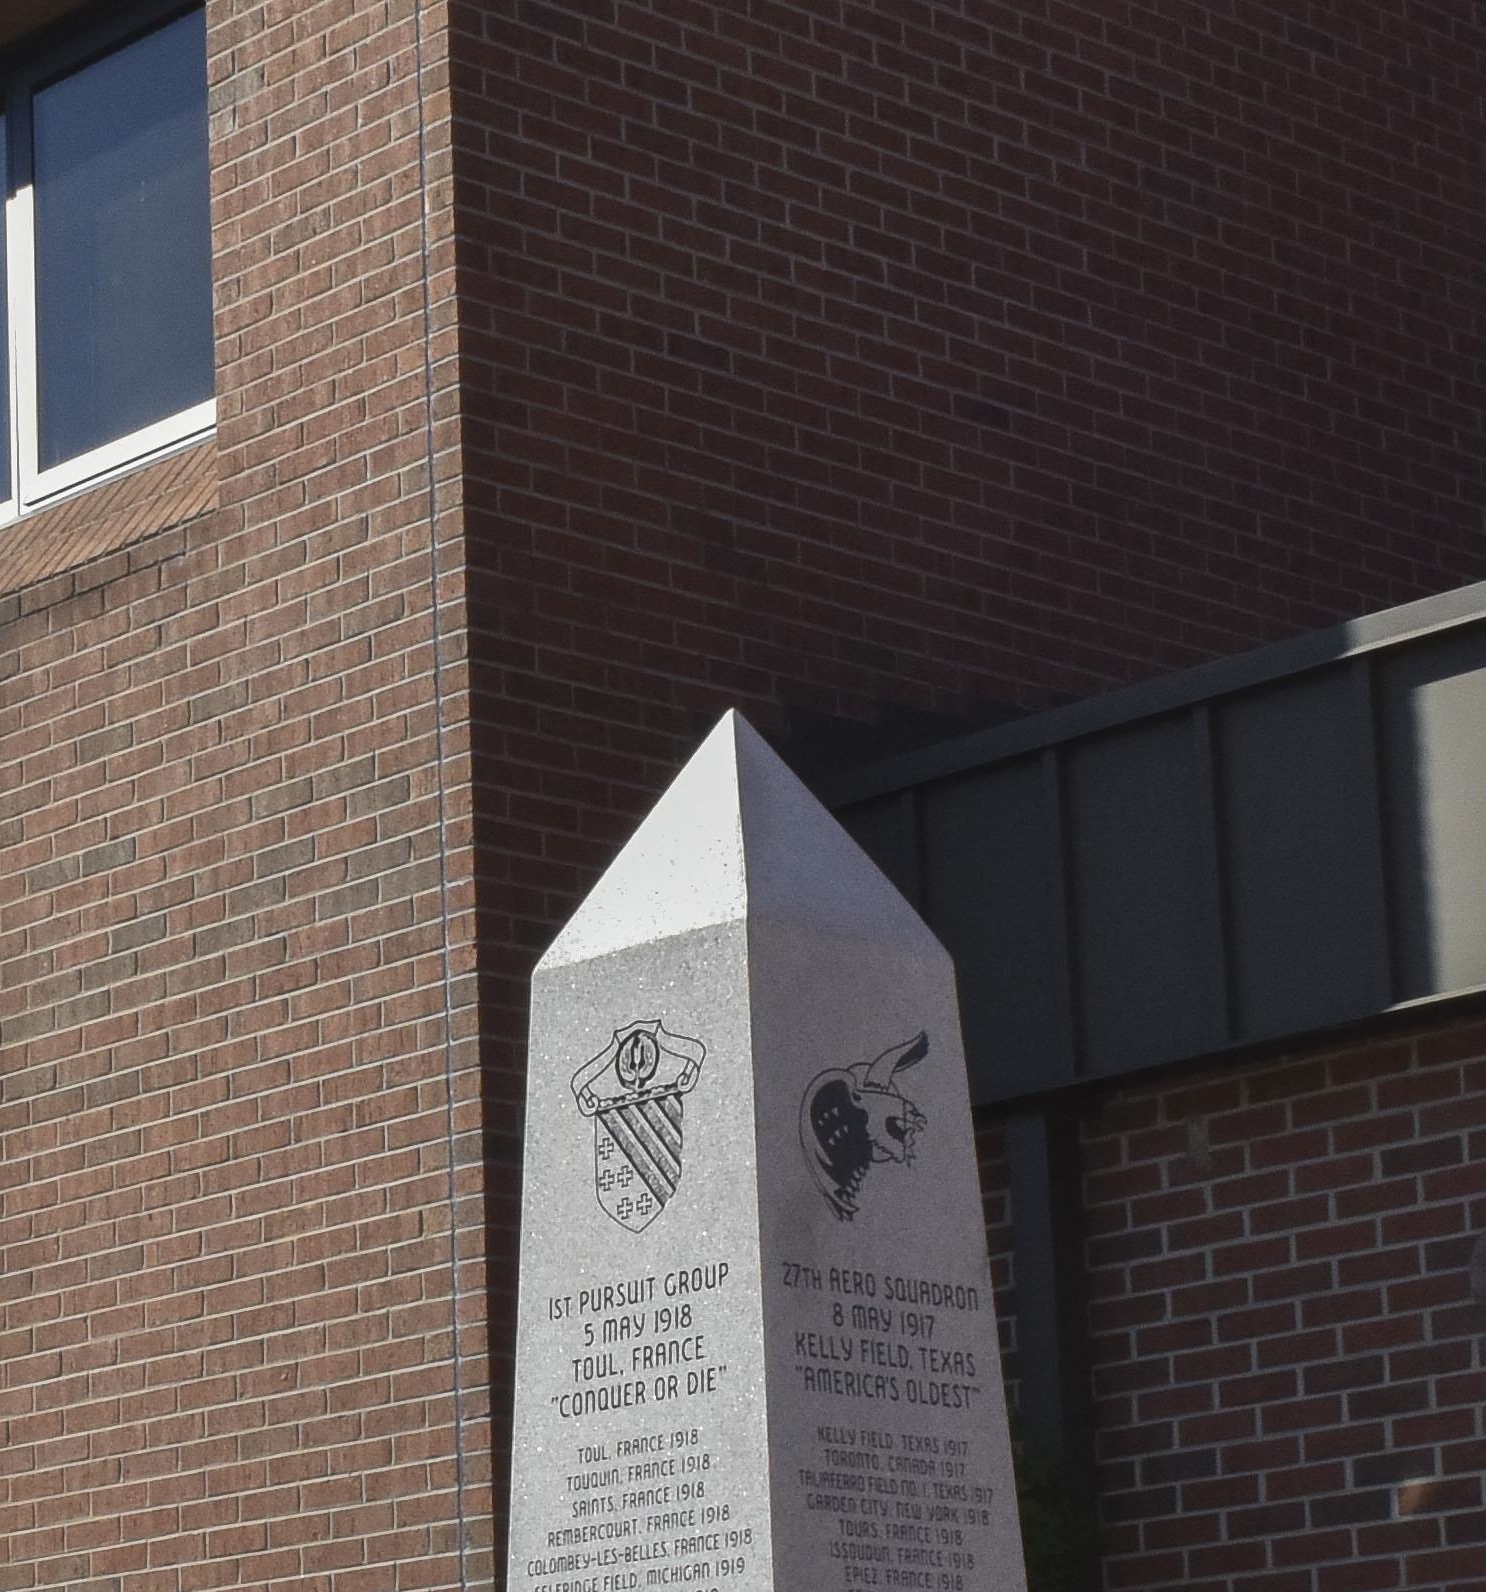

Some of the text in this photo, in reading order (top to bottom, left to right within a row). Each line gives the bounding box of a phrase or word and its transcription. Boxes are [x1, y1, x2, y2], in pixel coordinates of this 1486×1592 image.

[579, 1276, 654, 1314] PURSUIT
[664, 1261, 728, 1297] GROUP
[782, 1260, 979, 1312] 27TH AERO SQUADRON
[584, 1303, 691, 1347] 5 MAY 1918
[831, 1301, 936, 1339] 8 MAY 1917
[572, 1334, 704, 1382] TOUL, FRANCE
[794, 1330, 853, 1362] KELLY
[918, 1346, 976, 1377] TEXAS
[654, 1373, 677, 1401] OR
[616, 1434, 663, 1457] FRANCE
[670, 1428, 698, 1448] 1918
[628, 1458, 674, 1482] FRANCE
[681, 1452, 710, 1473] 1918
[622, 1486, 669, 1509] FRANCE
[676, 1480, 704, 1501] 1918
[646, 1509, 694, 1532] FRANCE
[701, 1503, 729, 1524] 1918
[674, 1532, 719, 1555] FRANCE
[724, 1527, 752, 1548] 1918
[646, 1561, 710, 1586] MICHIGAN
[715, 1556, 745, 1577] 1919
